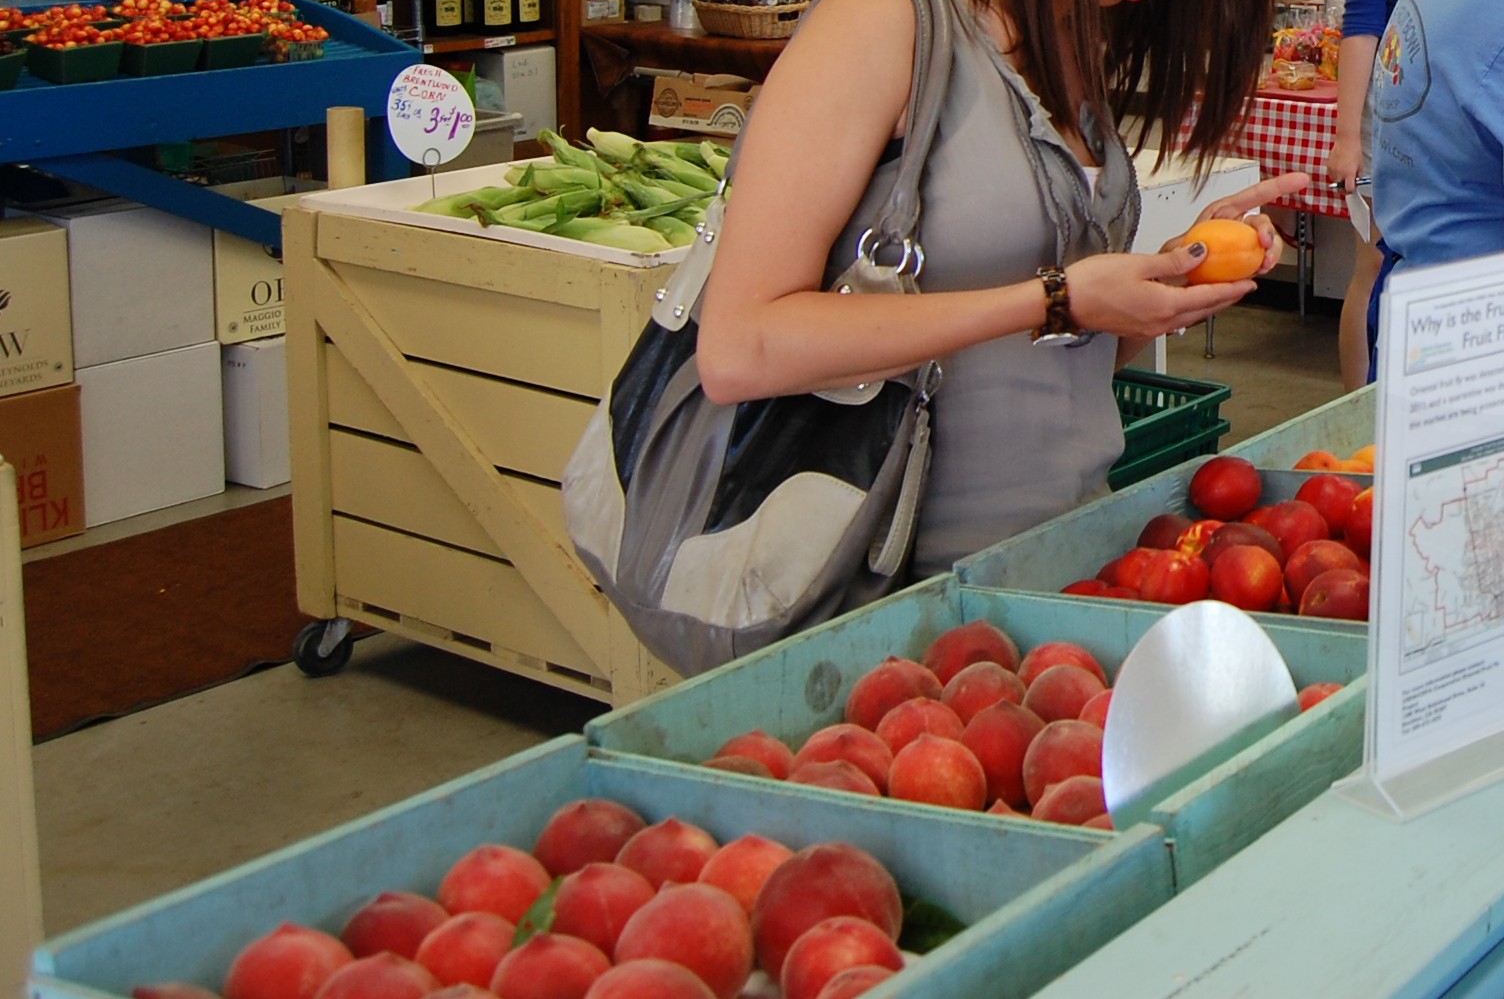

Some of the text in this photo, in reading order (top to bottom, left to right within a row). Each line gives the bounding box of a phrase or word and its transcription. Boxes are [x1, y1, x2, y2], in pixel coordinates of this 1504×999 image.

[1402, 21, 1421, 63] BOWL
[413, 65, 441, 77] FRESH
[403, 74, 458, 92] BRENTWOOD
[409, 86, 446, 101] CORN
[424, 107, 440, 133] 3
[243, 310, 281, 324] MAGGIO
[1411, 313, 1442, 336] Why
[1446, 313, 1456, 328] is
[1461, 307, 1485, 326] the
[250, 322, 281, 334] FAMILY
[1462, 329, 1492, 350] Fruit
[0, 360, 48, 377] EYNOLDS
